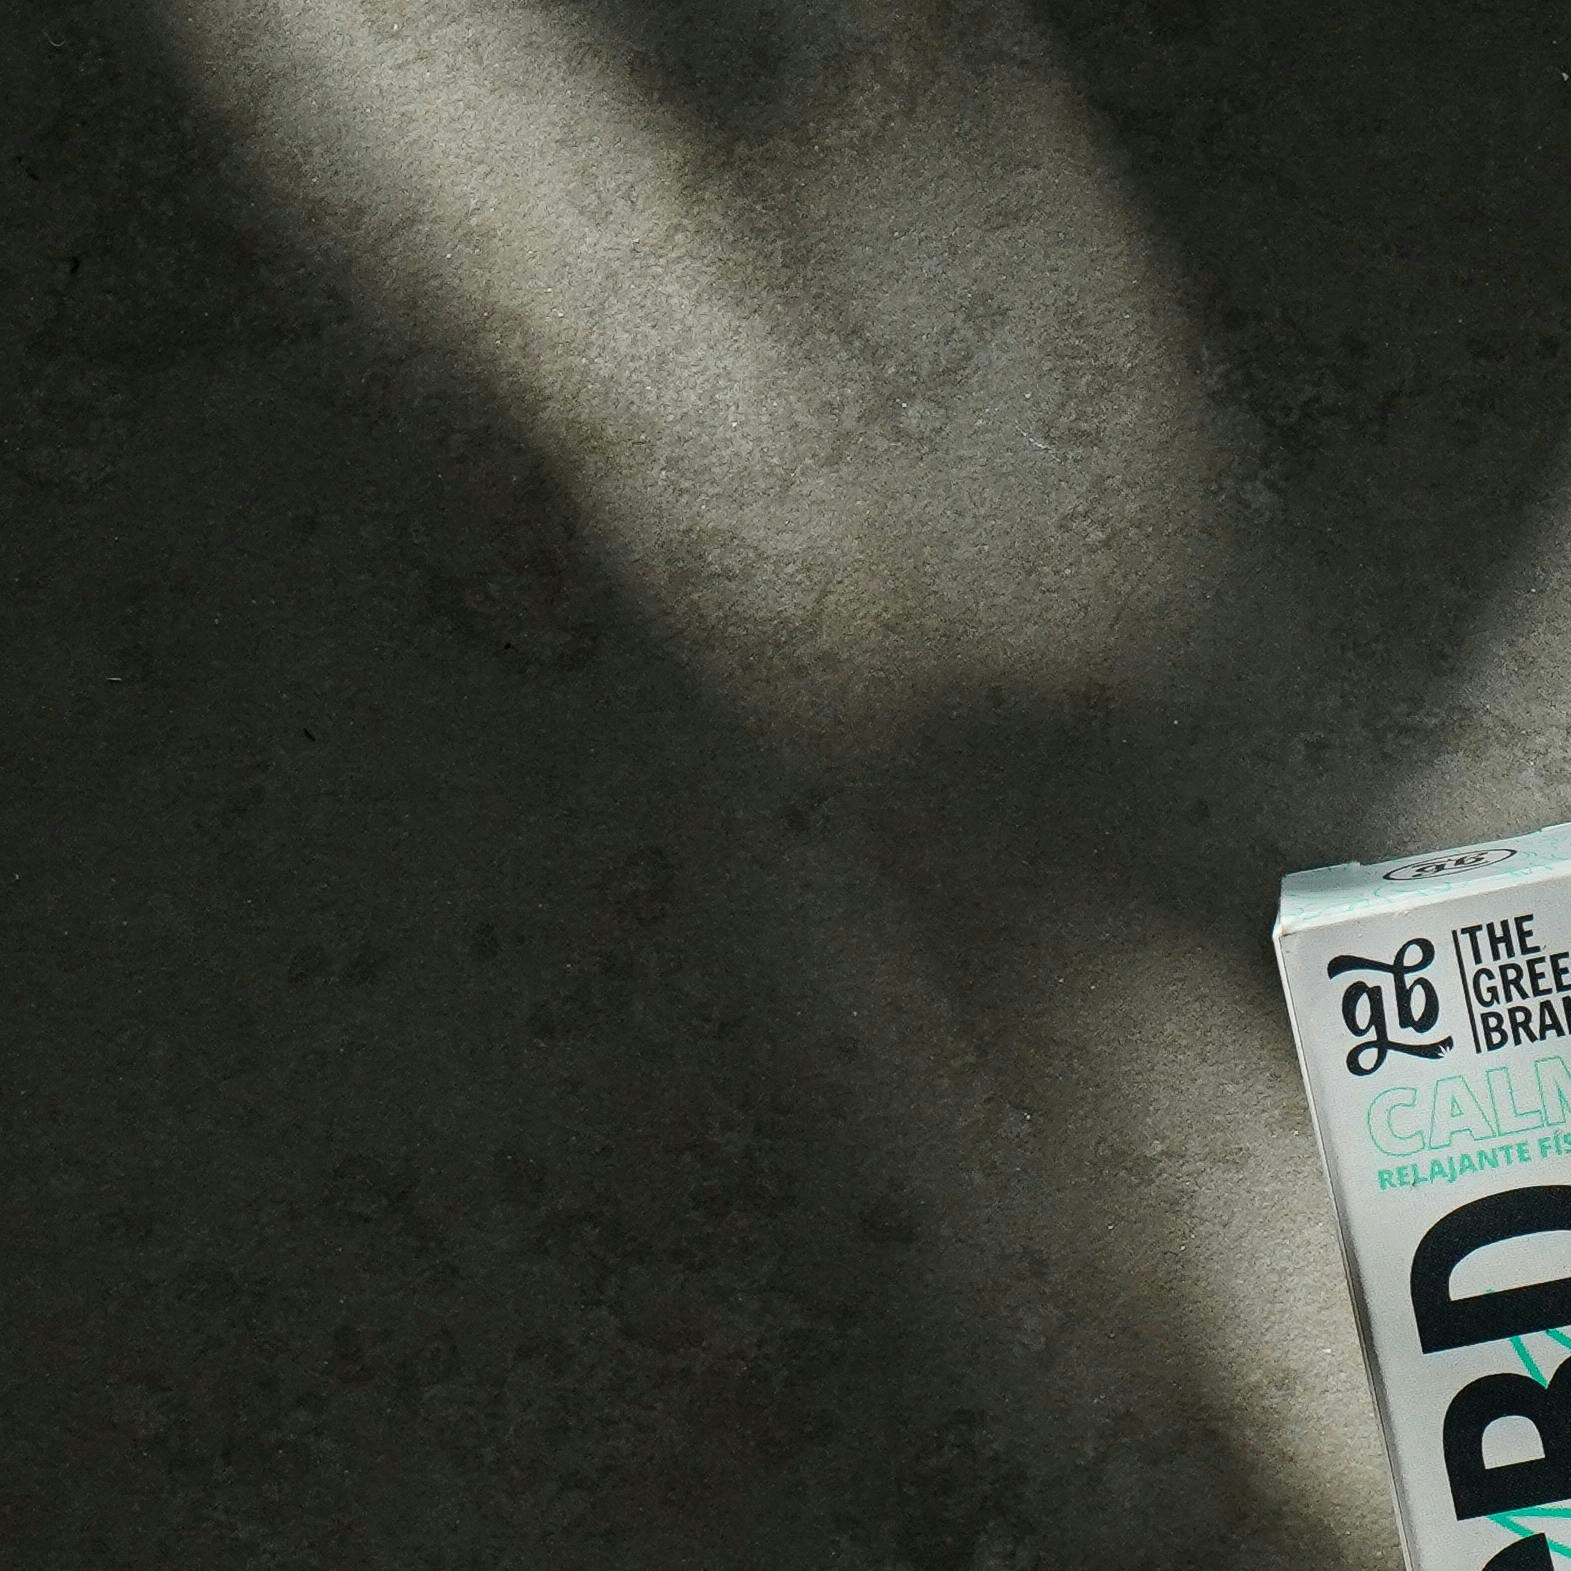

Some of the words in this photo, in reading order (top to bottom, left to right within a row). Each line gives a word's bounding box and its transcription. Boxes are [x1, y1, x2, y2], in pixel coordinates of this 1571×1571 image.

[1460, 913, 1541, 965] THE
[1326, 937, 1454, 1077] gb
[1376, 1140, 1531, 1191] RELAJANTE
